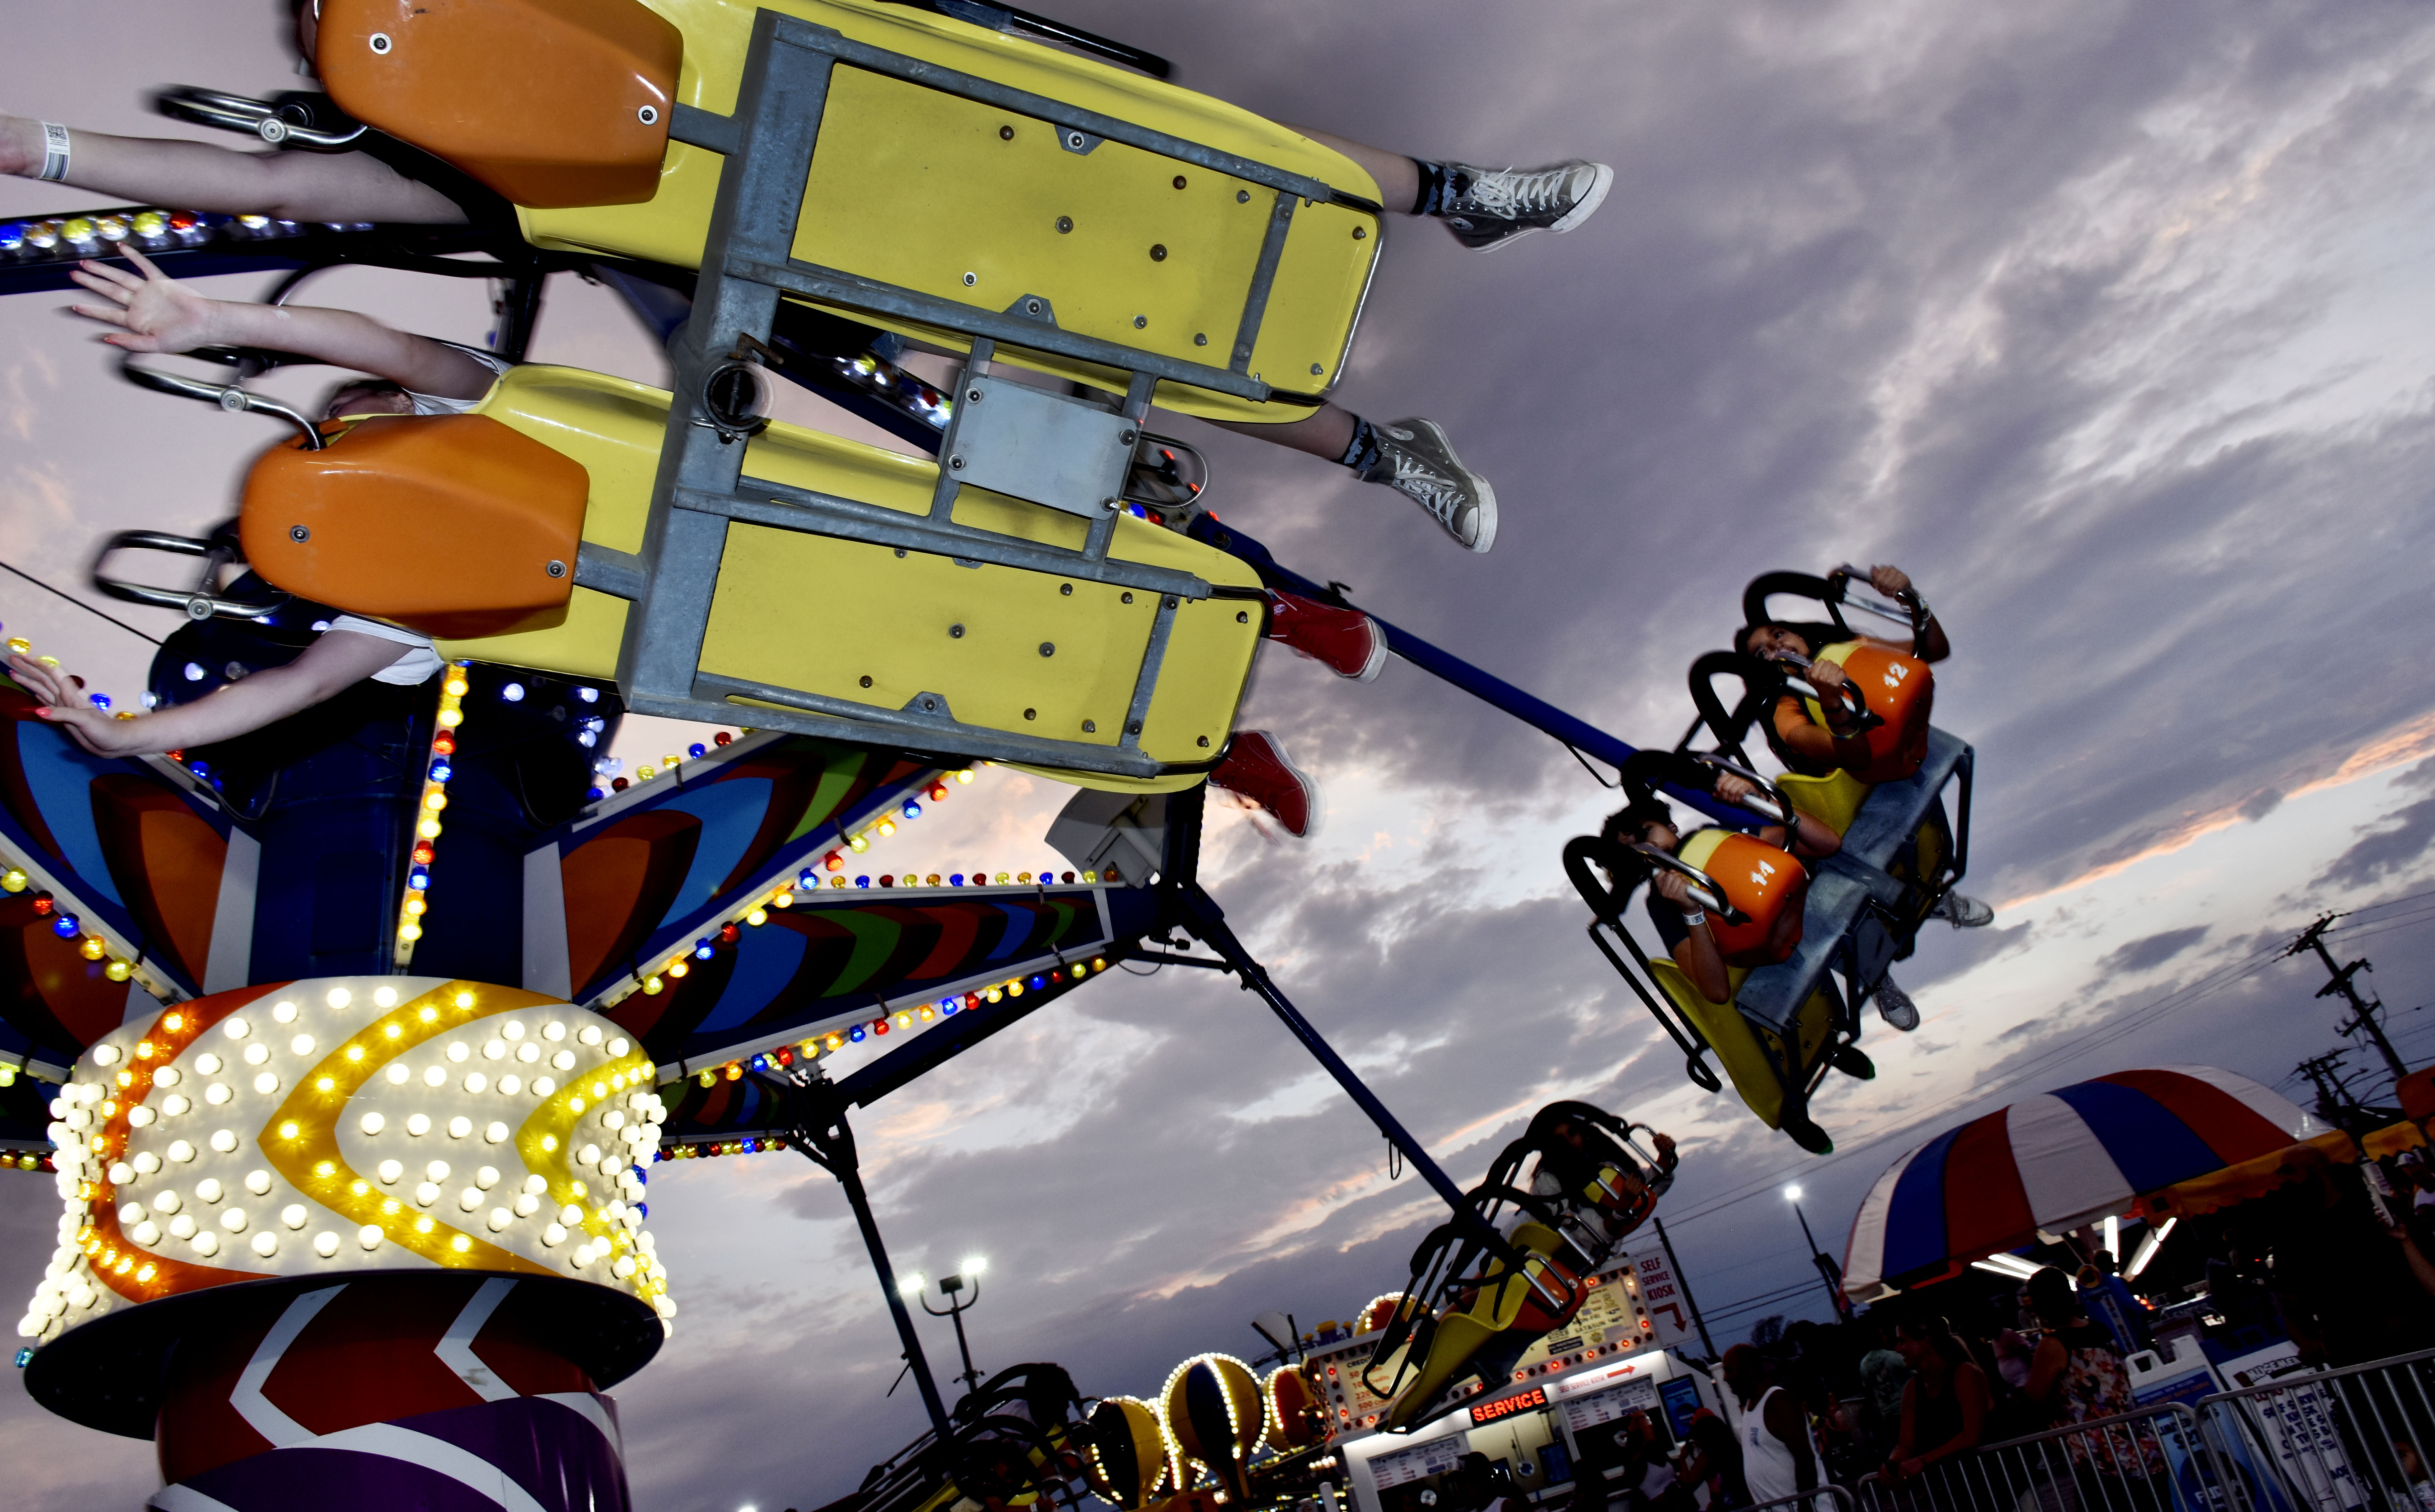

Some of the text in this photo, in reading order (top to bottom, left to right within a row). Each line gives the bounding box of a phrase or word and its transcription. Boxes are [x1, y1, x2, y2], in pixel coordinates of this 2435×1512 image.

[1884, 663, 1908, 688] 12
[1641, 1257, 1661, 1273] SELF
[1642, 1271, 1670, 1286] SERVICE
[1646, 1283, 1675, 1301] KIOSK
[1570, 1379, 1590, 1390] SERVICE
[1590, 1374, 1605, 1384] KIOSK
[1358, 1400, 1373, 1409] 500
[1472, 1388, 1545, 1422] SERVICE
[2288, 1389, 2329, 1409] SRVIE
